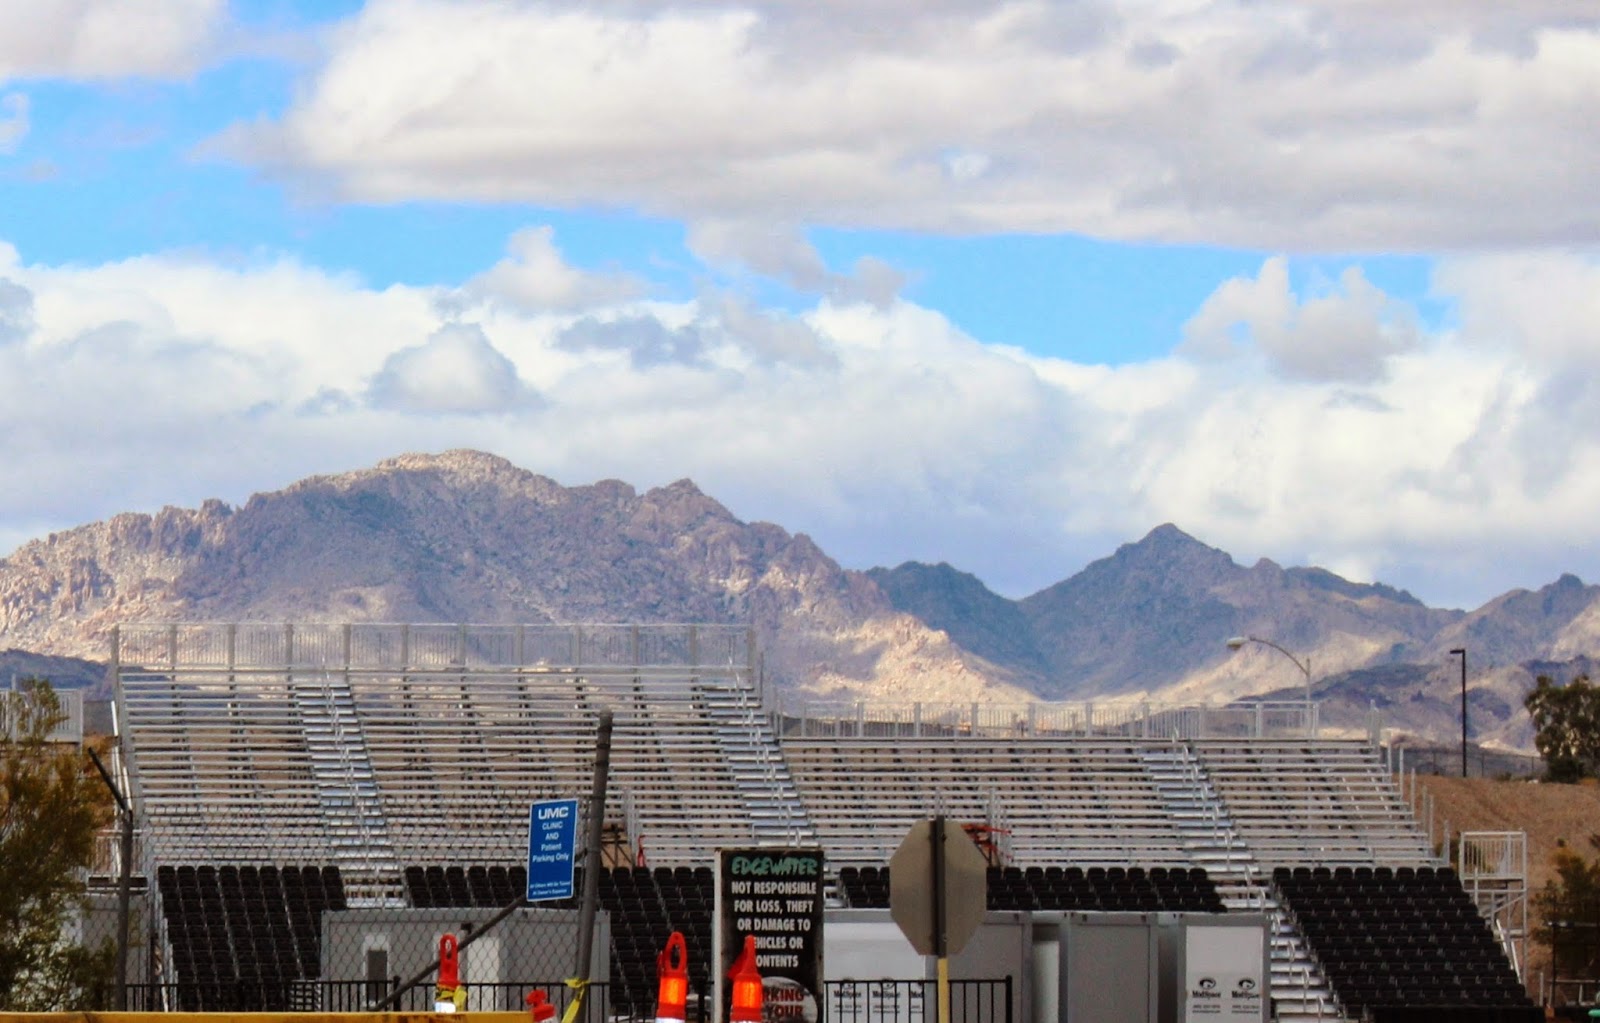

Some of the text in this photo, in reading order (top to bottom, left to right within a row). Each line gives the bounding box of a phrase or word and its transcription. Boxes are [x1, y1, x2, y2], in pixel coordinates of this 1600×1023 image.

[538, 806, 569, 820] UMC
[542, 821, 563, 831] CLINIC
[545, 832, 559, 841] AND
[541, 843, 562, 852] Patient
[532, 852, 570, 863] Parking Only
[731, 856, 818, 876] EDGEWATER
[731, 881, 817, 895] NOT RESPONSIBLE
[734, 900, 814, 914] FOR LOSS, THEFT
[737, 918, 811, 931] OR DAMAGE TO
[753, 936, 804, 949] HICLES OR
[755, 954, 799, 967] ONTENTS
[763, 986, 804, 1001] RKING
